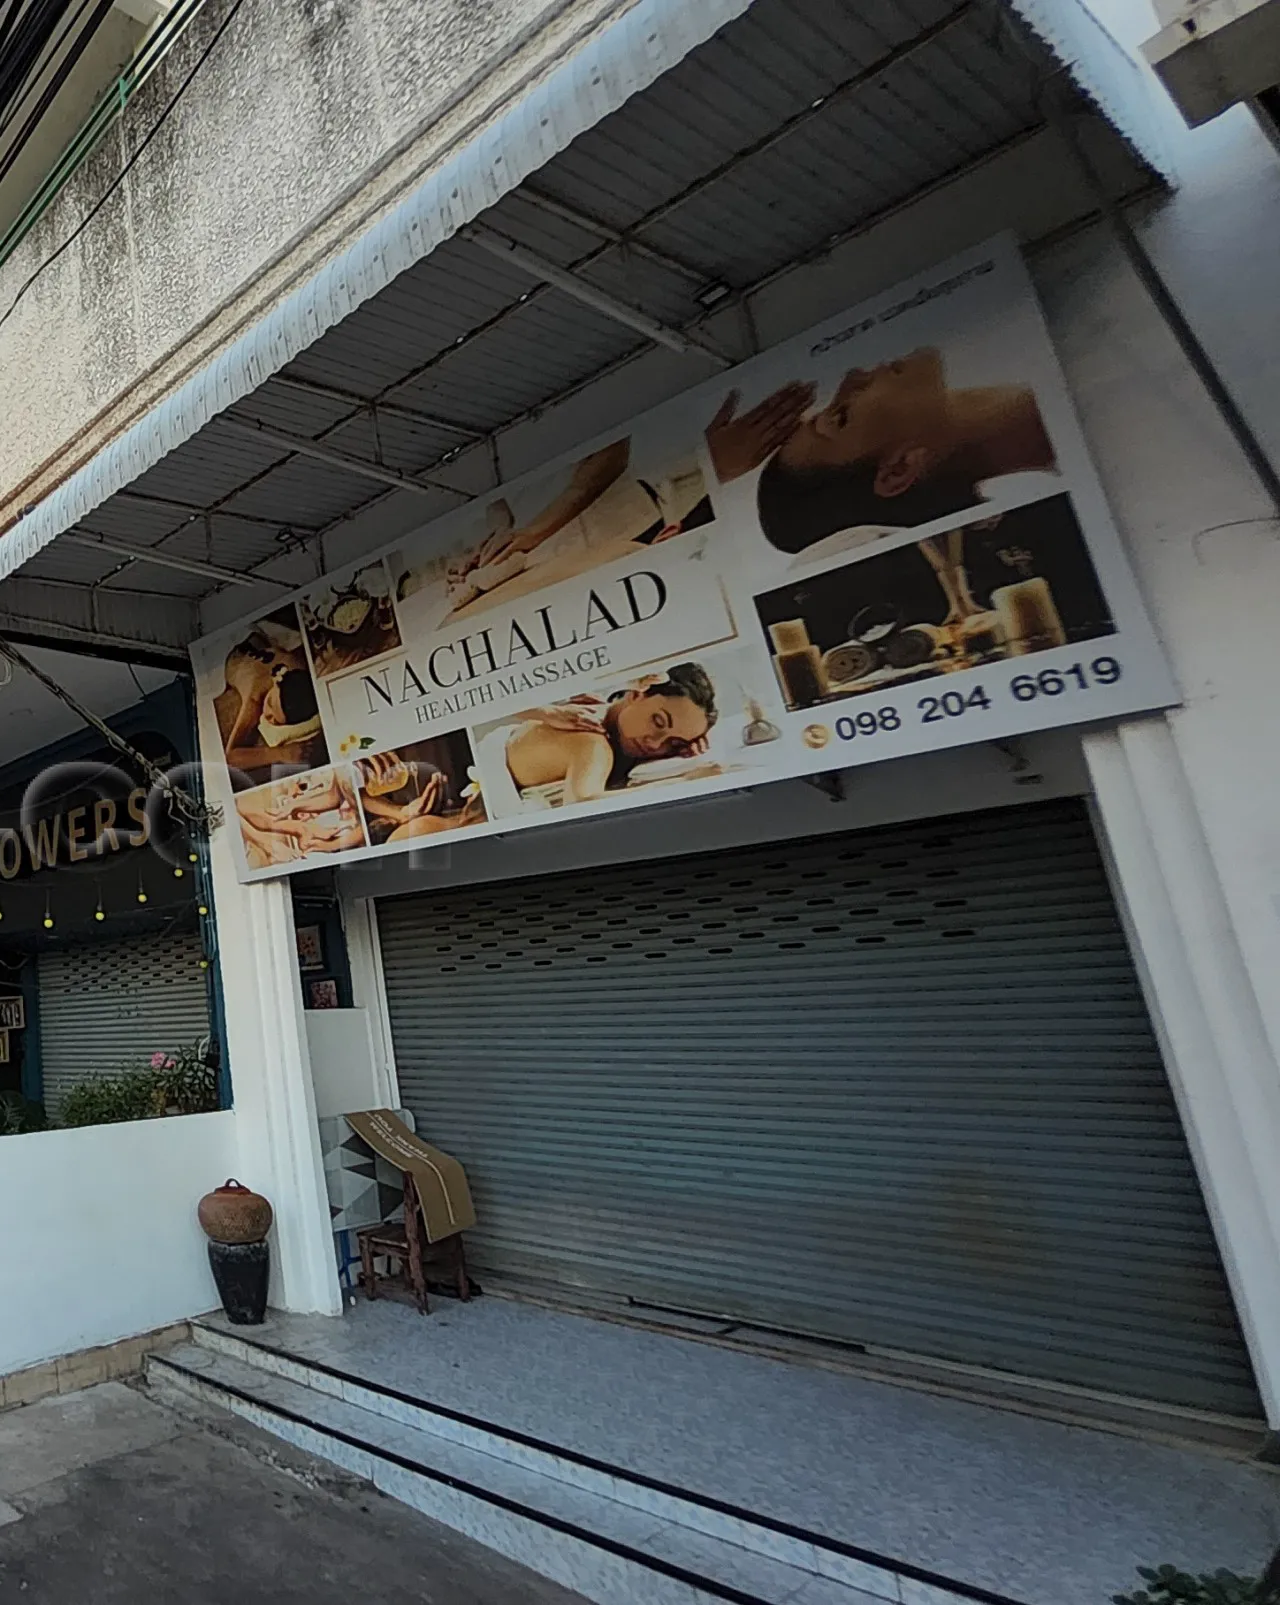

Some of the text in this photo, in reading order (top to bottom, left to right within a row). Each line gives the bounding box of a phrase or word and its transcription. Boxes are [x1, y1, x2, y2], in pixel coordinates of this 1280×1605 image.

[360, 571, 667, 715] NACHALAD
[415, 645, 612, 724] HEALTH MASSAGE
[835, 656, 1122, 741] 098 204 6619
